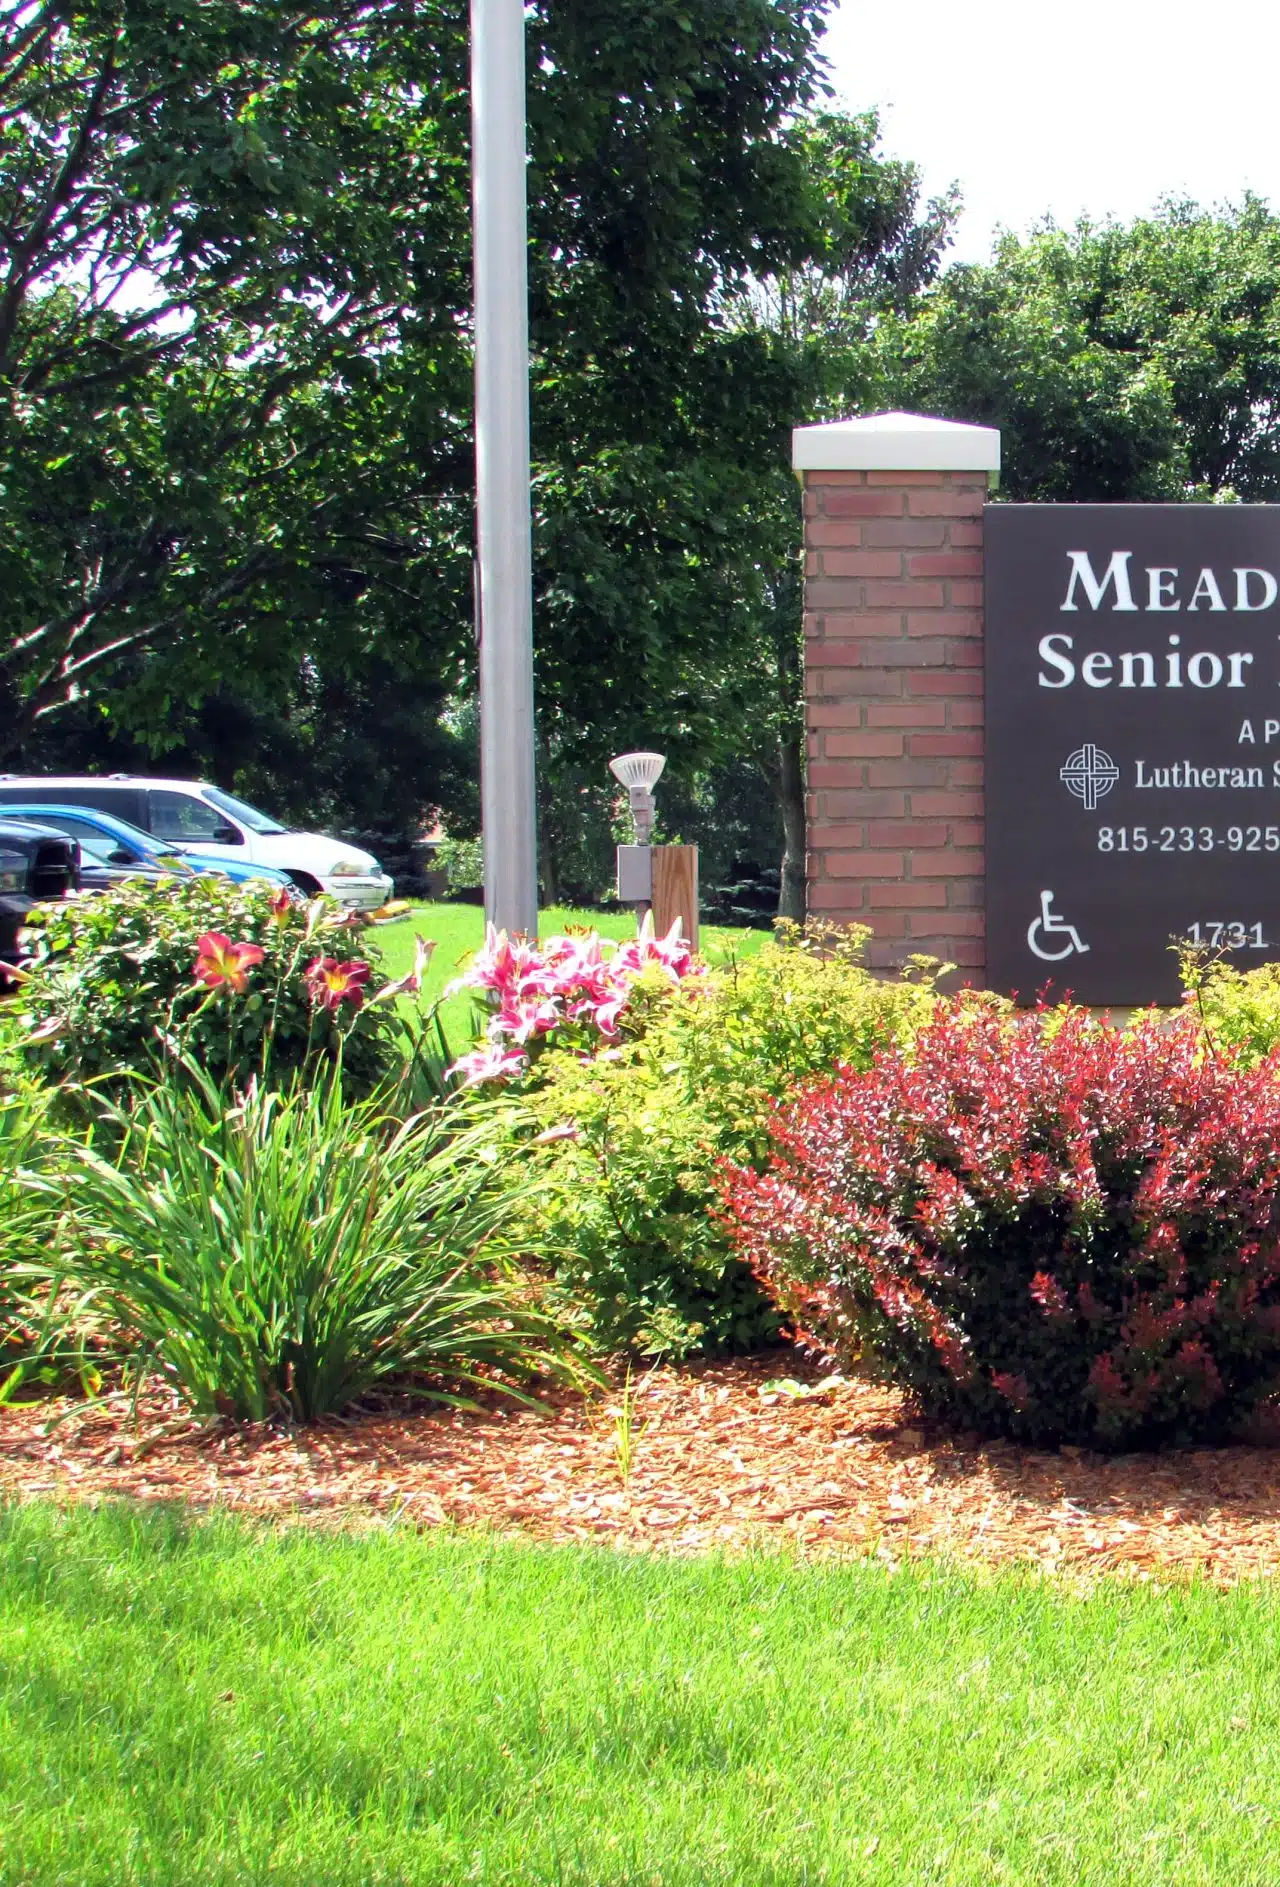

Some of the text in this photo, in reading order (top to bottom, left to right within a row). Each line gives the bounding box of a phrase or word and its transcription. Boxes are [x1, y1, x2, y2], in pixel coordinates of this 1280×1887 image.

[1038, 633, 1254, 689] Senior
[1238, 719, 1256, 744] A
[1135, 760, 1265, 788] Lutheran
[1187, 921, 1269, 948] 1731
